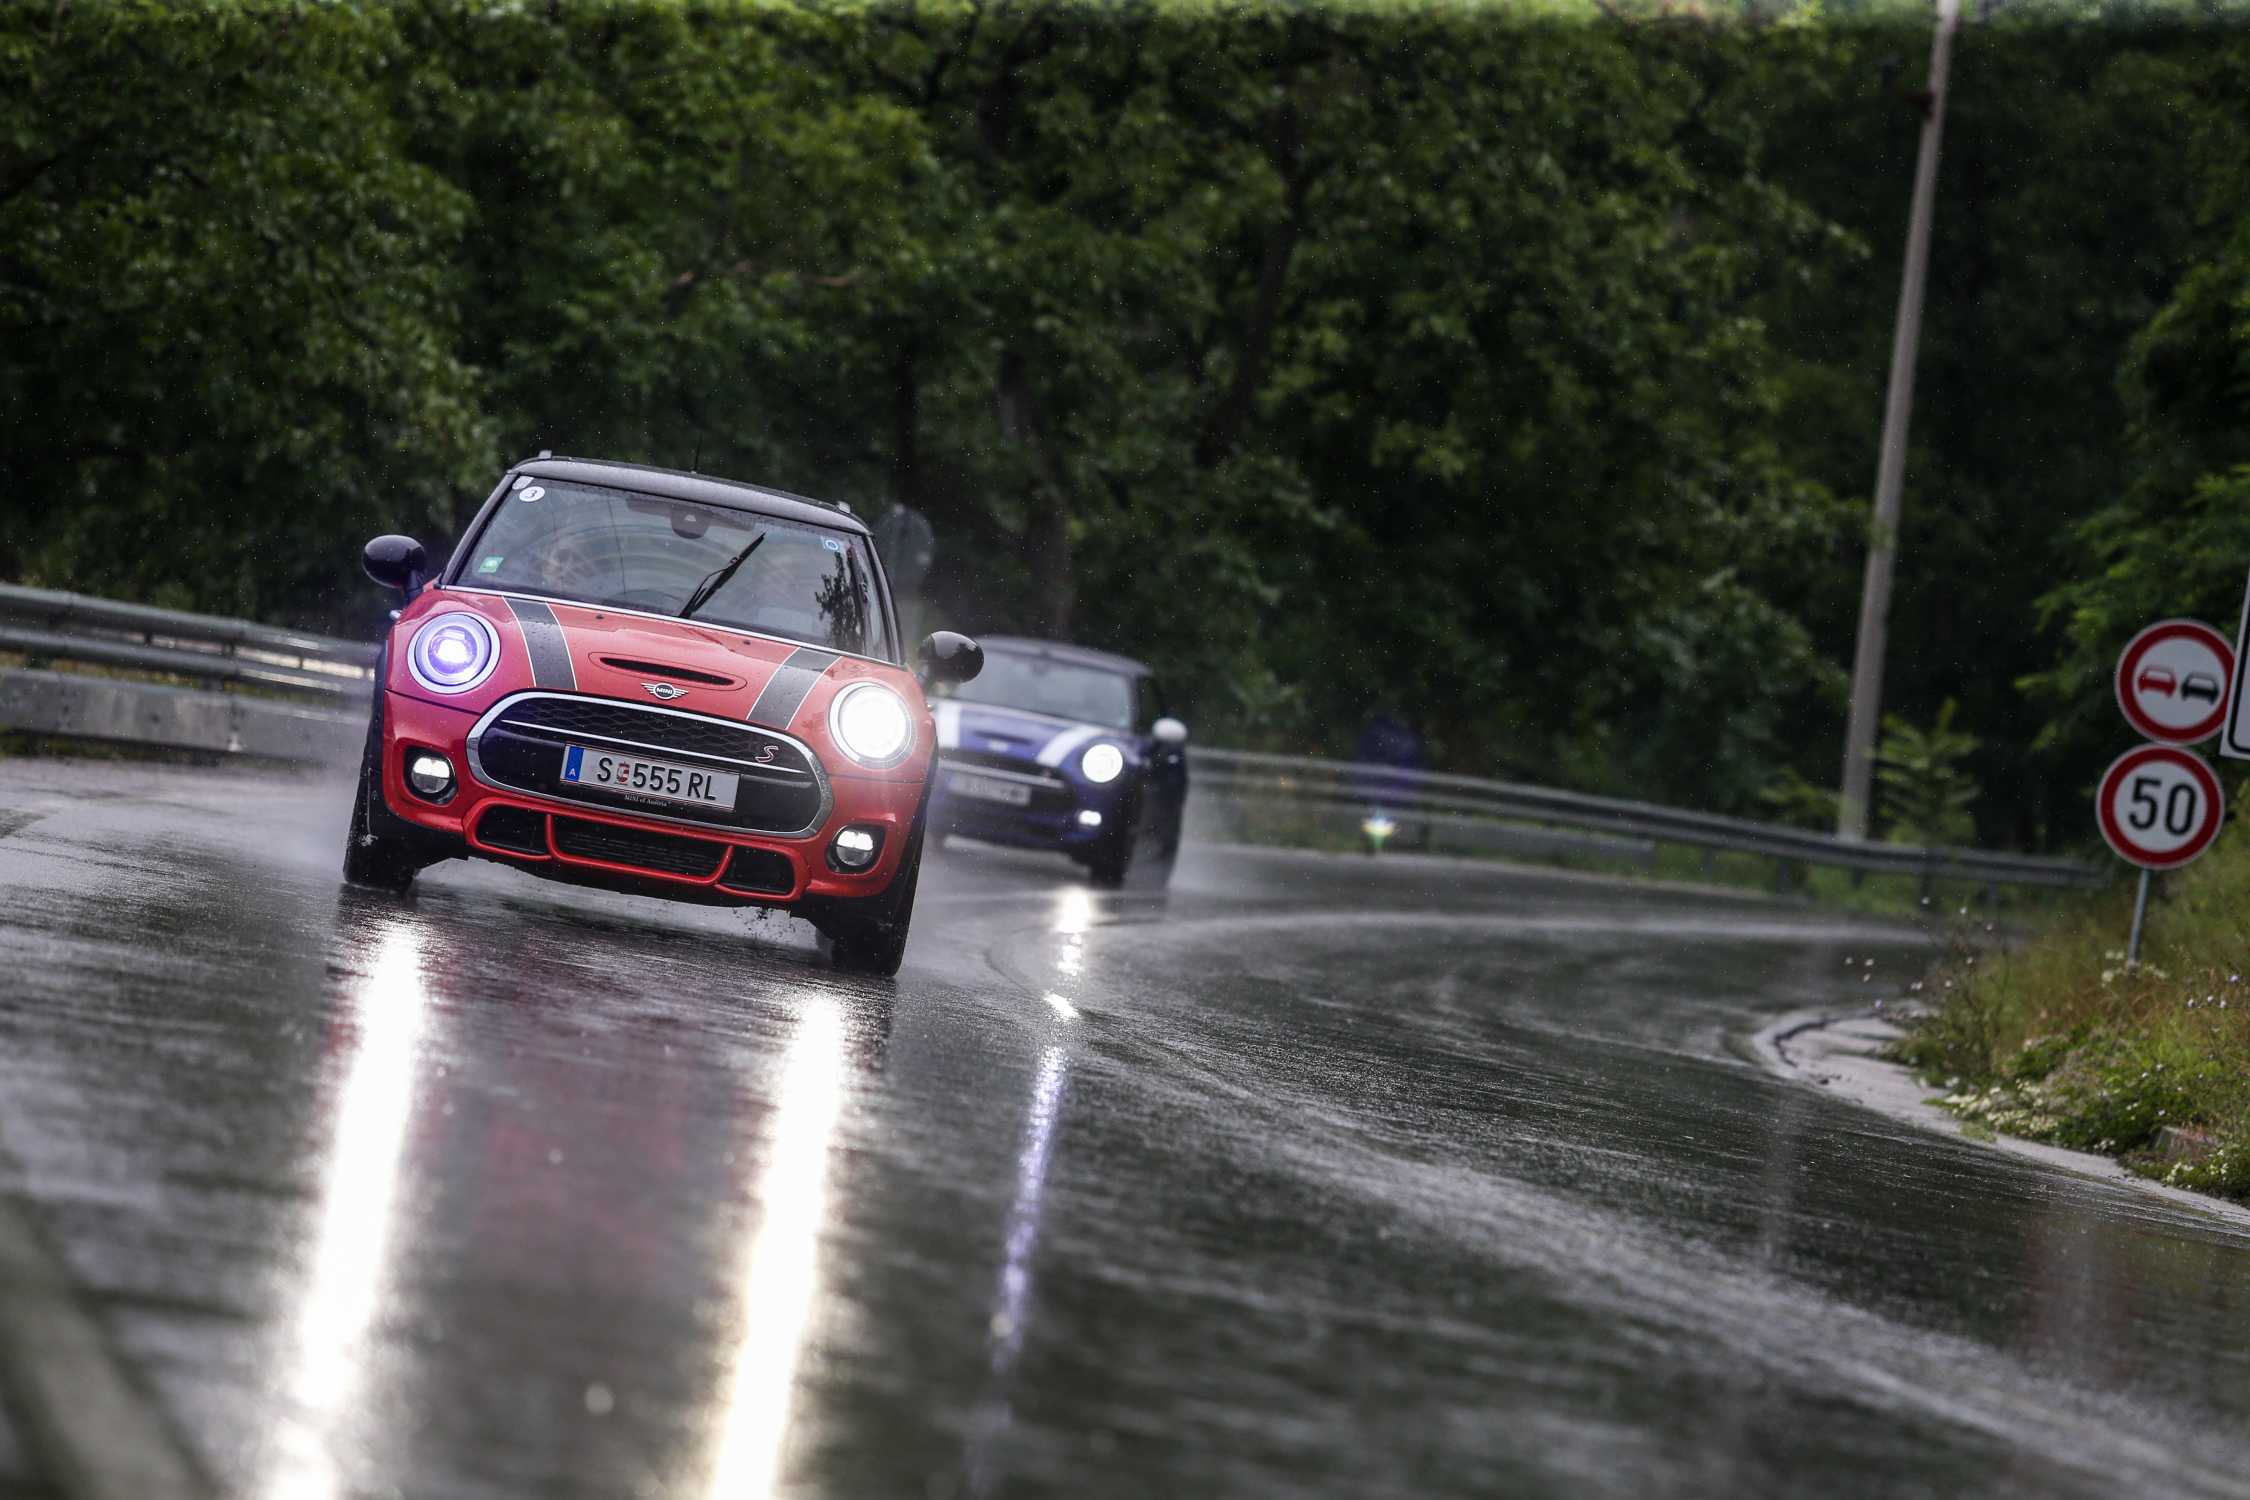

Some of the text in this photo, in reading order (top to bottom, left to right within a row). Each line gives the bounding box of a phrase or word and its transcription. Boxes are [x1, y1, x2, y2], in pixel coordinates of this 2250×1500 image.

[656, 687, 673, 695] MINI
[755, 745, 779, 763] S
[568, 767, 577, 777] A
[597, 757, 716, 800] S 555 RL
[2129, 776, 2197, 836] 50
